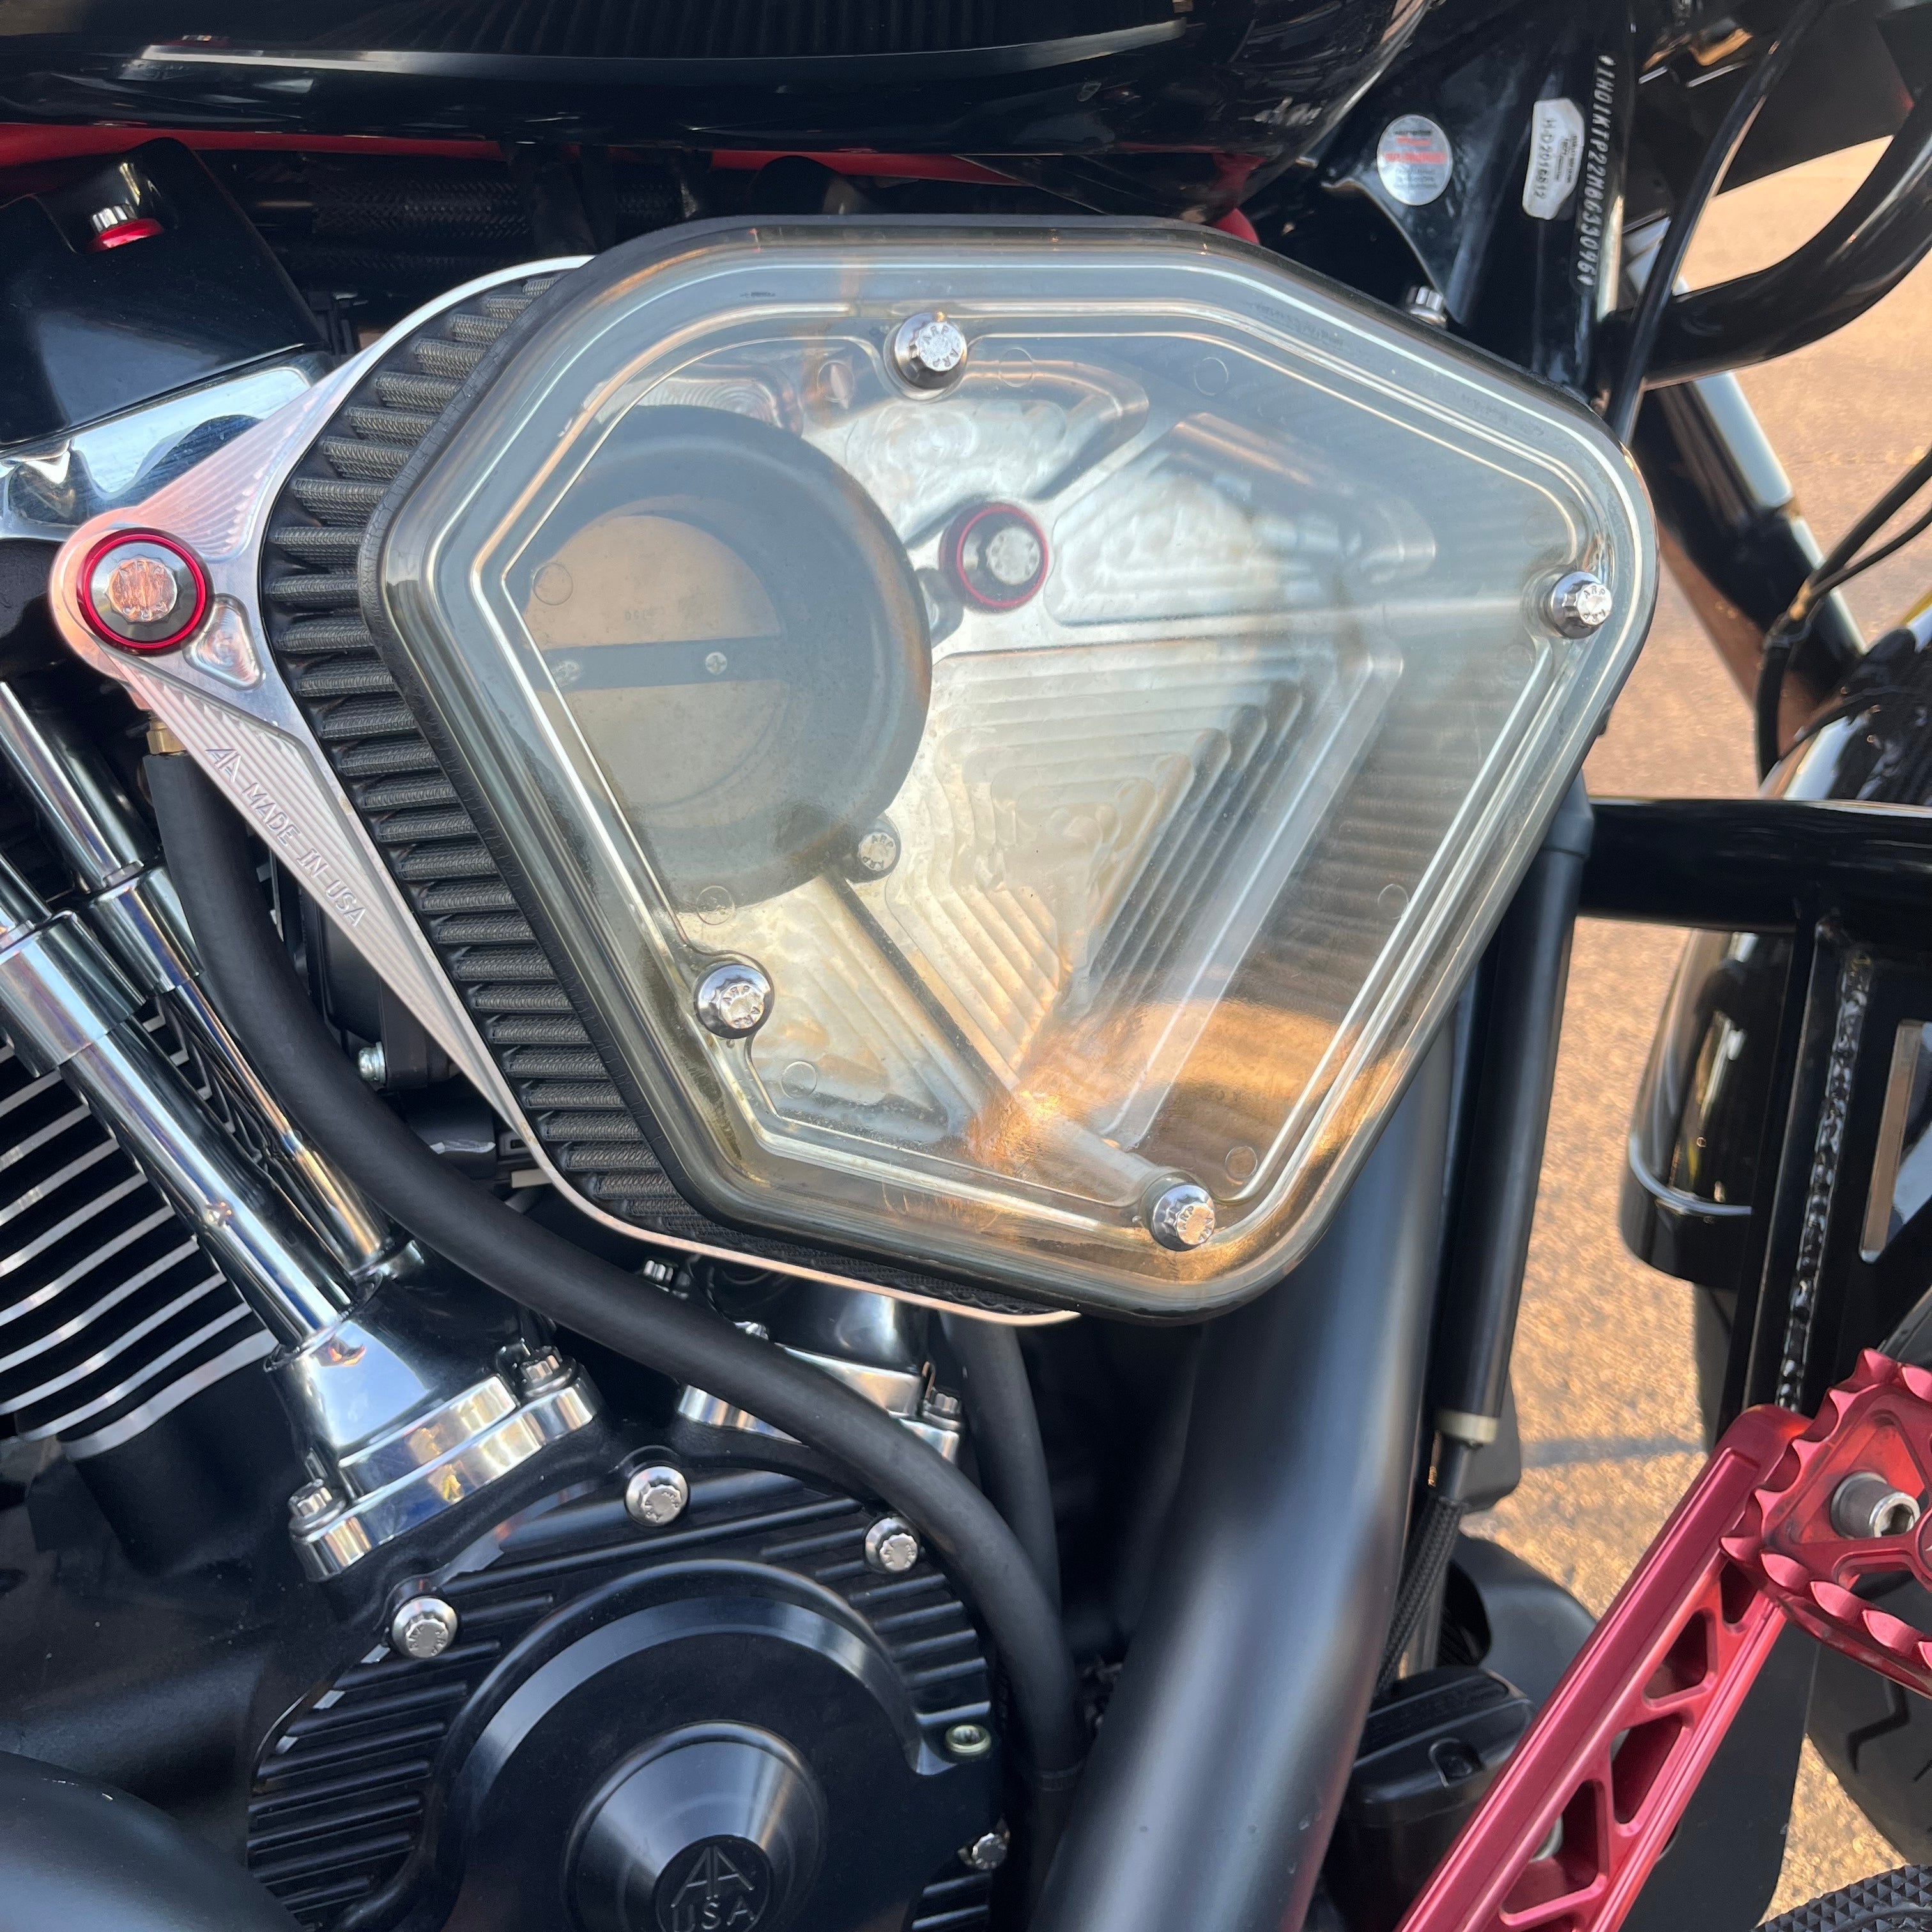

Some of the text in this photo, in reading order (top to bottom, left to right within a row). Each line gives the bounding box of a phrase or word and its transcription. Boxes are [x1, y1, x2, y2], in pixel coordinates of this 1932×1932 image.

[923, 325, 949, 345] ARP
[933, 348, 959, 367] ARP
[1583, 585, 1606, 599] ARP
[871, 834, 894, 848] ARP
[241, 782, 301, 847] MADE
[296, 848, 328, 878] IN
[325, 879, 367, 927] USA
[723, 985, 751, 1006] ARP
[1179, 1206, 1194, 1230] ARP
[673, 1896, 755, 1932] USA
